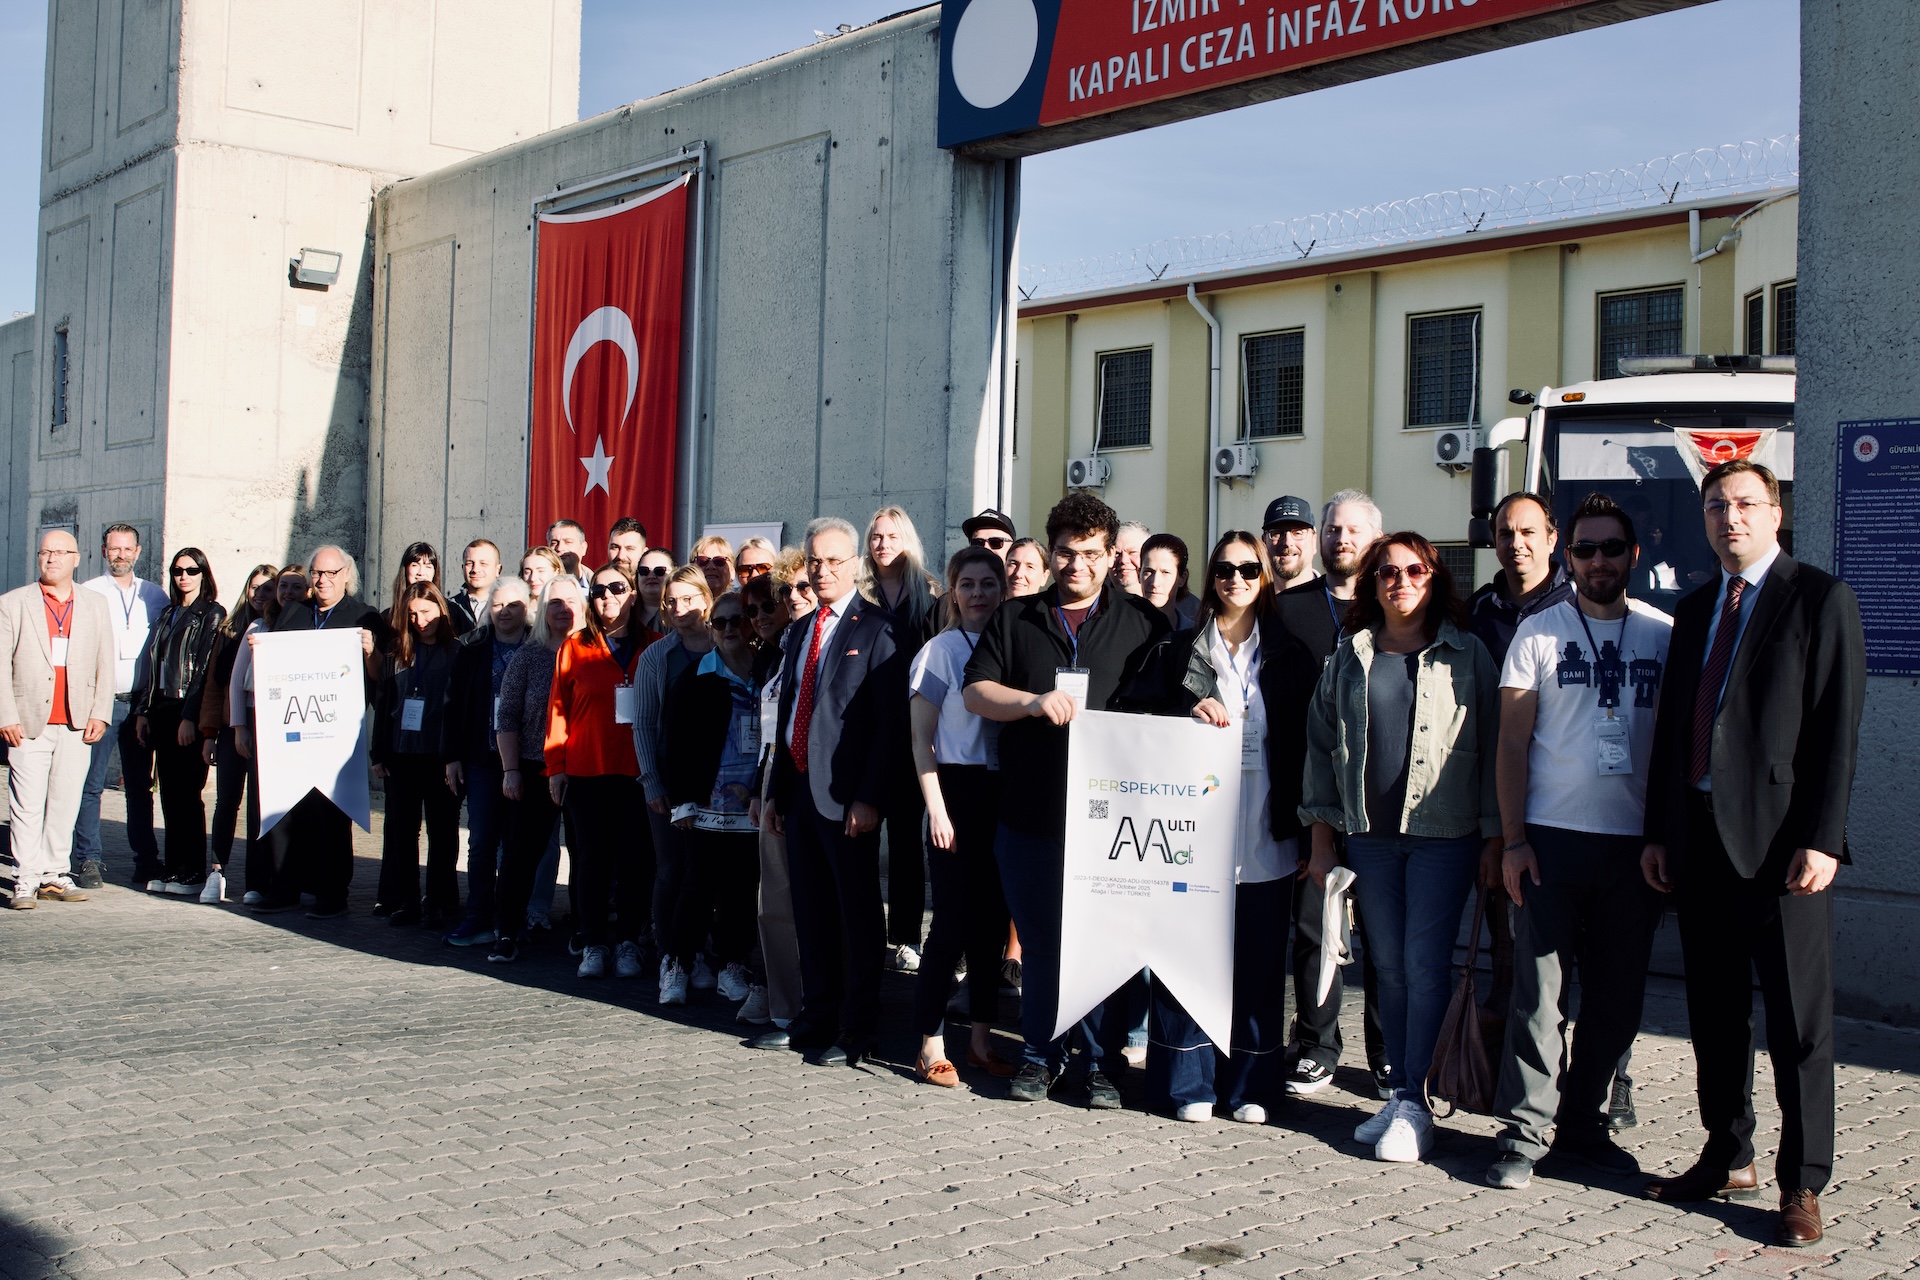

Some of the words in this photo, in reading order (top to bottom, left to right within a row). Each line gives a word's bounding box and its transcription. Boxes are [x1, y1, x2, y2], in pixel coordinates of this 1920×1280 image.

[1069, 43, 1170, 102] KAPALI
[1179, 22, 1256, 73] CEZA
[1267, 0, 1367, 54] İNFAZ
[268, 672, 337, 682] PERSPEKTIVE
[1562, 671, 1585, 679] GAMI
[1636, 668, 1656, 677] TION
[1088, 778, 1197, 797] PERSPEKTIVE
